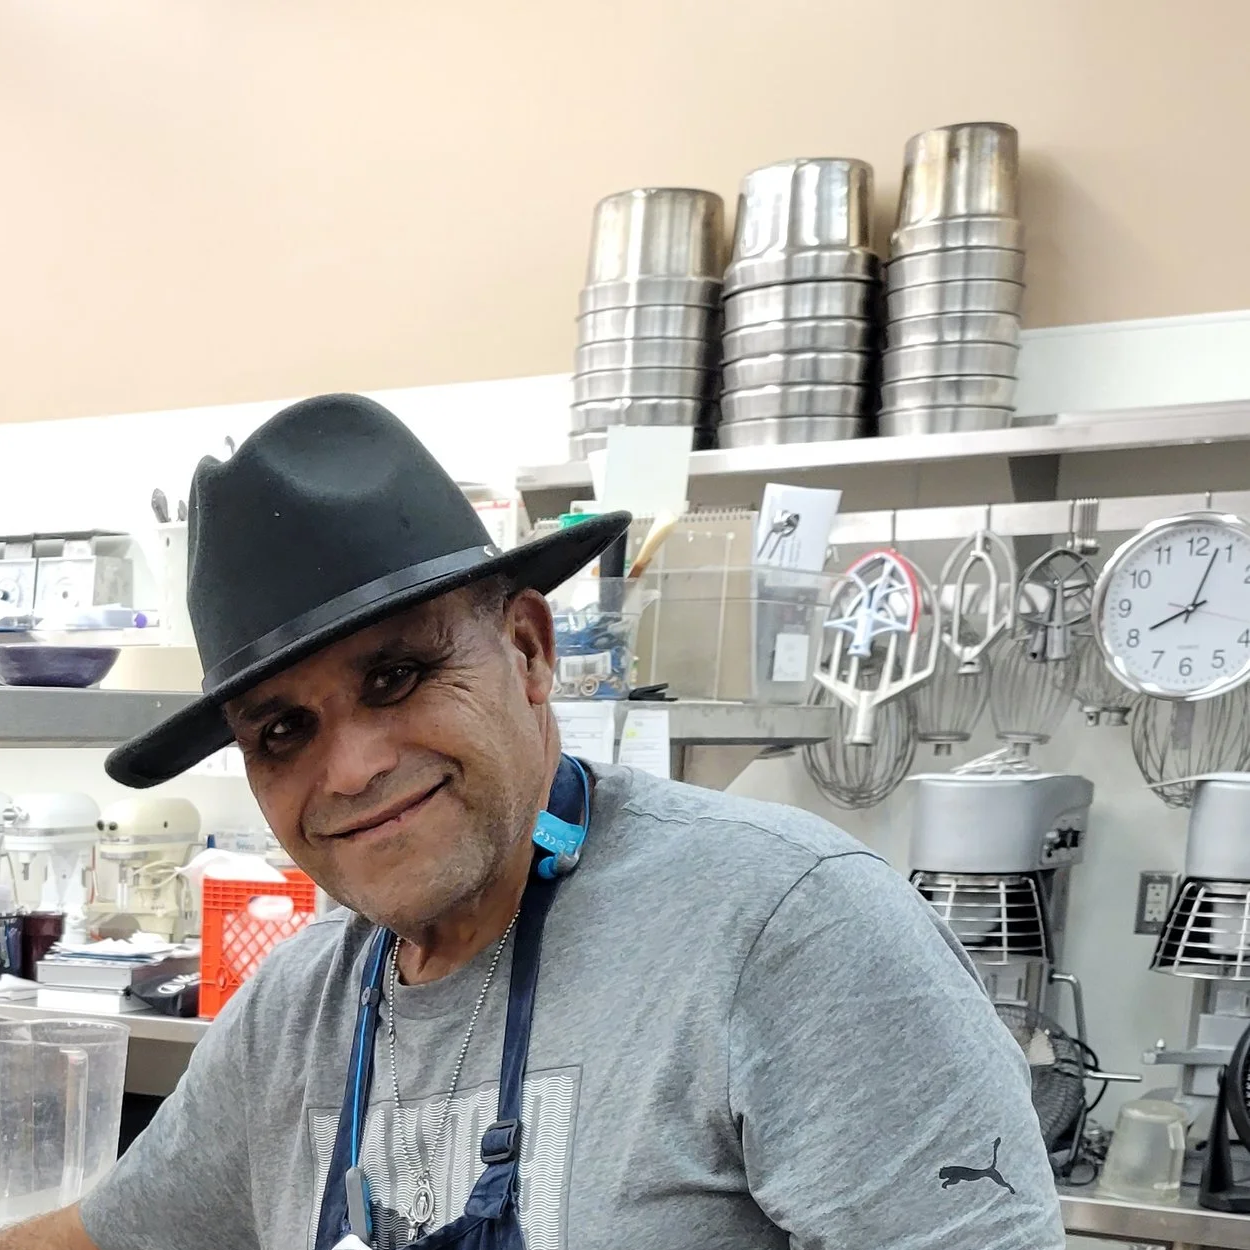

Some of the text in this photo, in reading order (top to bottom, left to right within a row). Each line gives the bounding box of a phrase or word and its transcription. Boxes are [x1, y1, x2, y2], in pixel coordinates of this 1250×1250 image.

[1156, 545, 1172, 565] 11
[1186, 536, 1210, 556] 12
[1225, 544, 1233, 563] 1
[1130, 569, 1152, 589] 10
[1118, 598, 1132, 618] 9
[1126, 628, 1140, 648] 8
[1237, 628, 1250, 648] 4
[1151, 650, 1165, 669] 7
[1178, 657, 1193, 677] 6
[1211, 649, 1225, 669] 5
